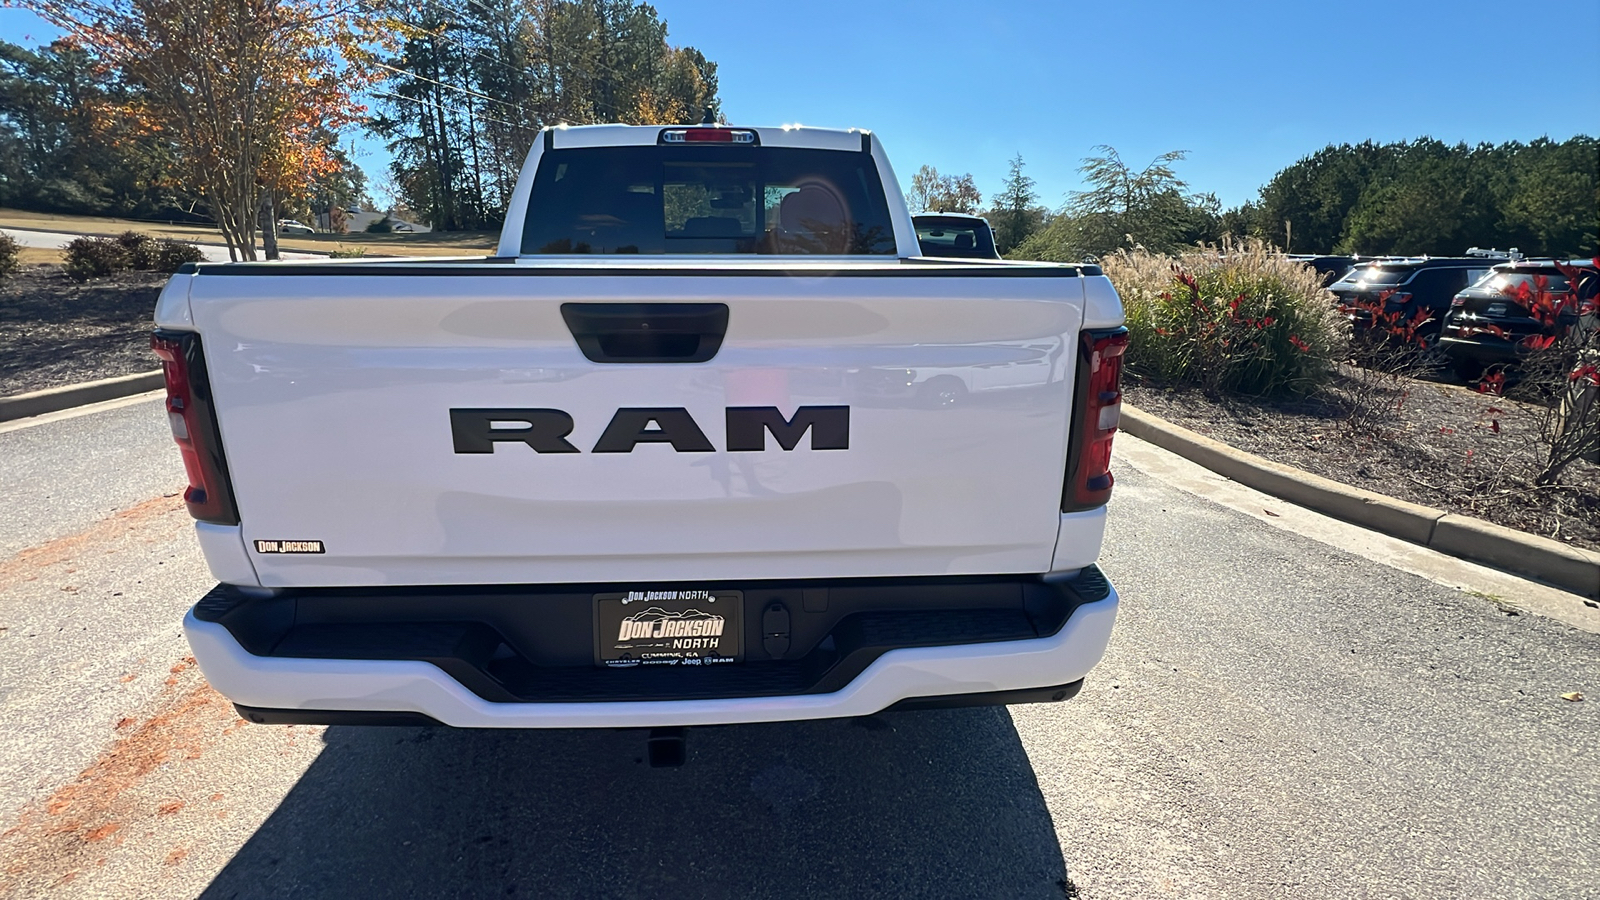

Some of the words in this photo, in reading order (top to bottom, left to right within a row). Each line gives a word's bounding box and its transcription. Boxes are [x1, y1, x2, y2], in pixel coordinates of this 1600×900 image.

[449, 405, 850, 454] RAM
[258, 541, 278, 552] DON
[279, 541, 320, 552] JACKSON
[628, 591, 644, 602] DON
[644, 591, 678, 602] JACKSON
[678, 591, 709, 600] NORTH
[618, 620, 654, 641] DON
[653, 619, 725, 638] JACKSON
[672, 638, 719, 649] NORTH
